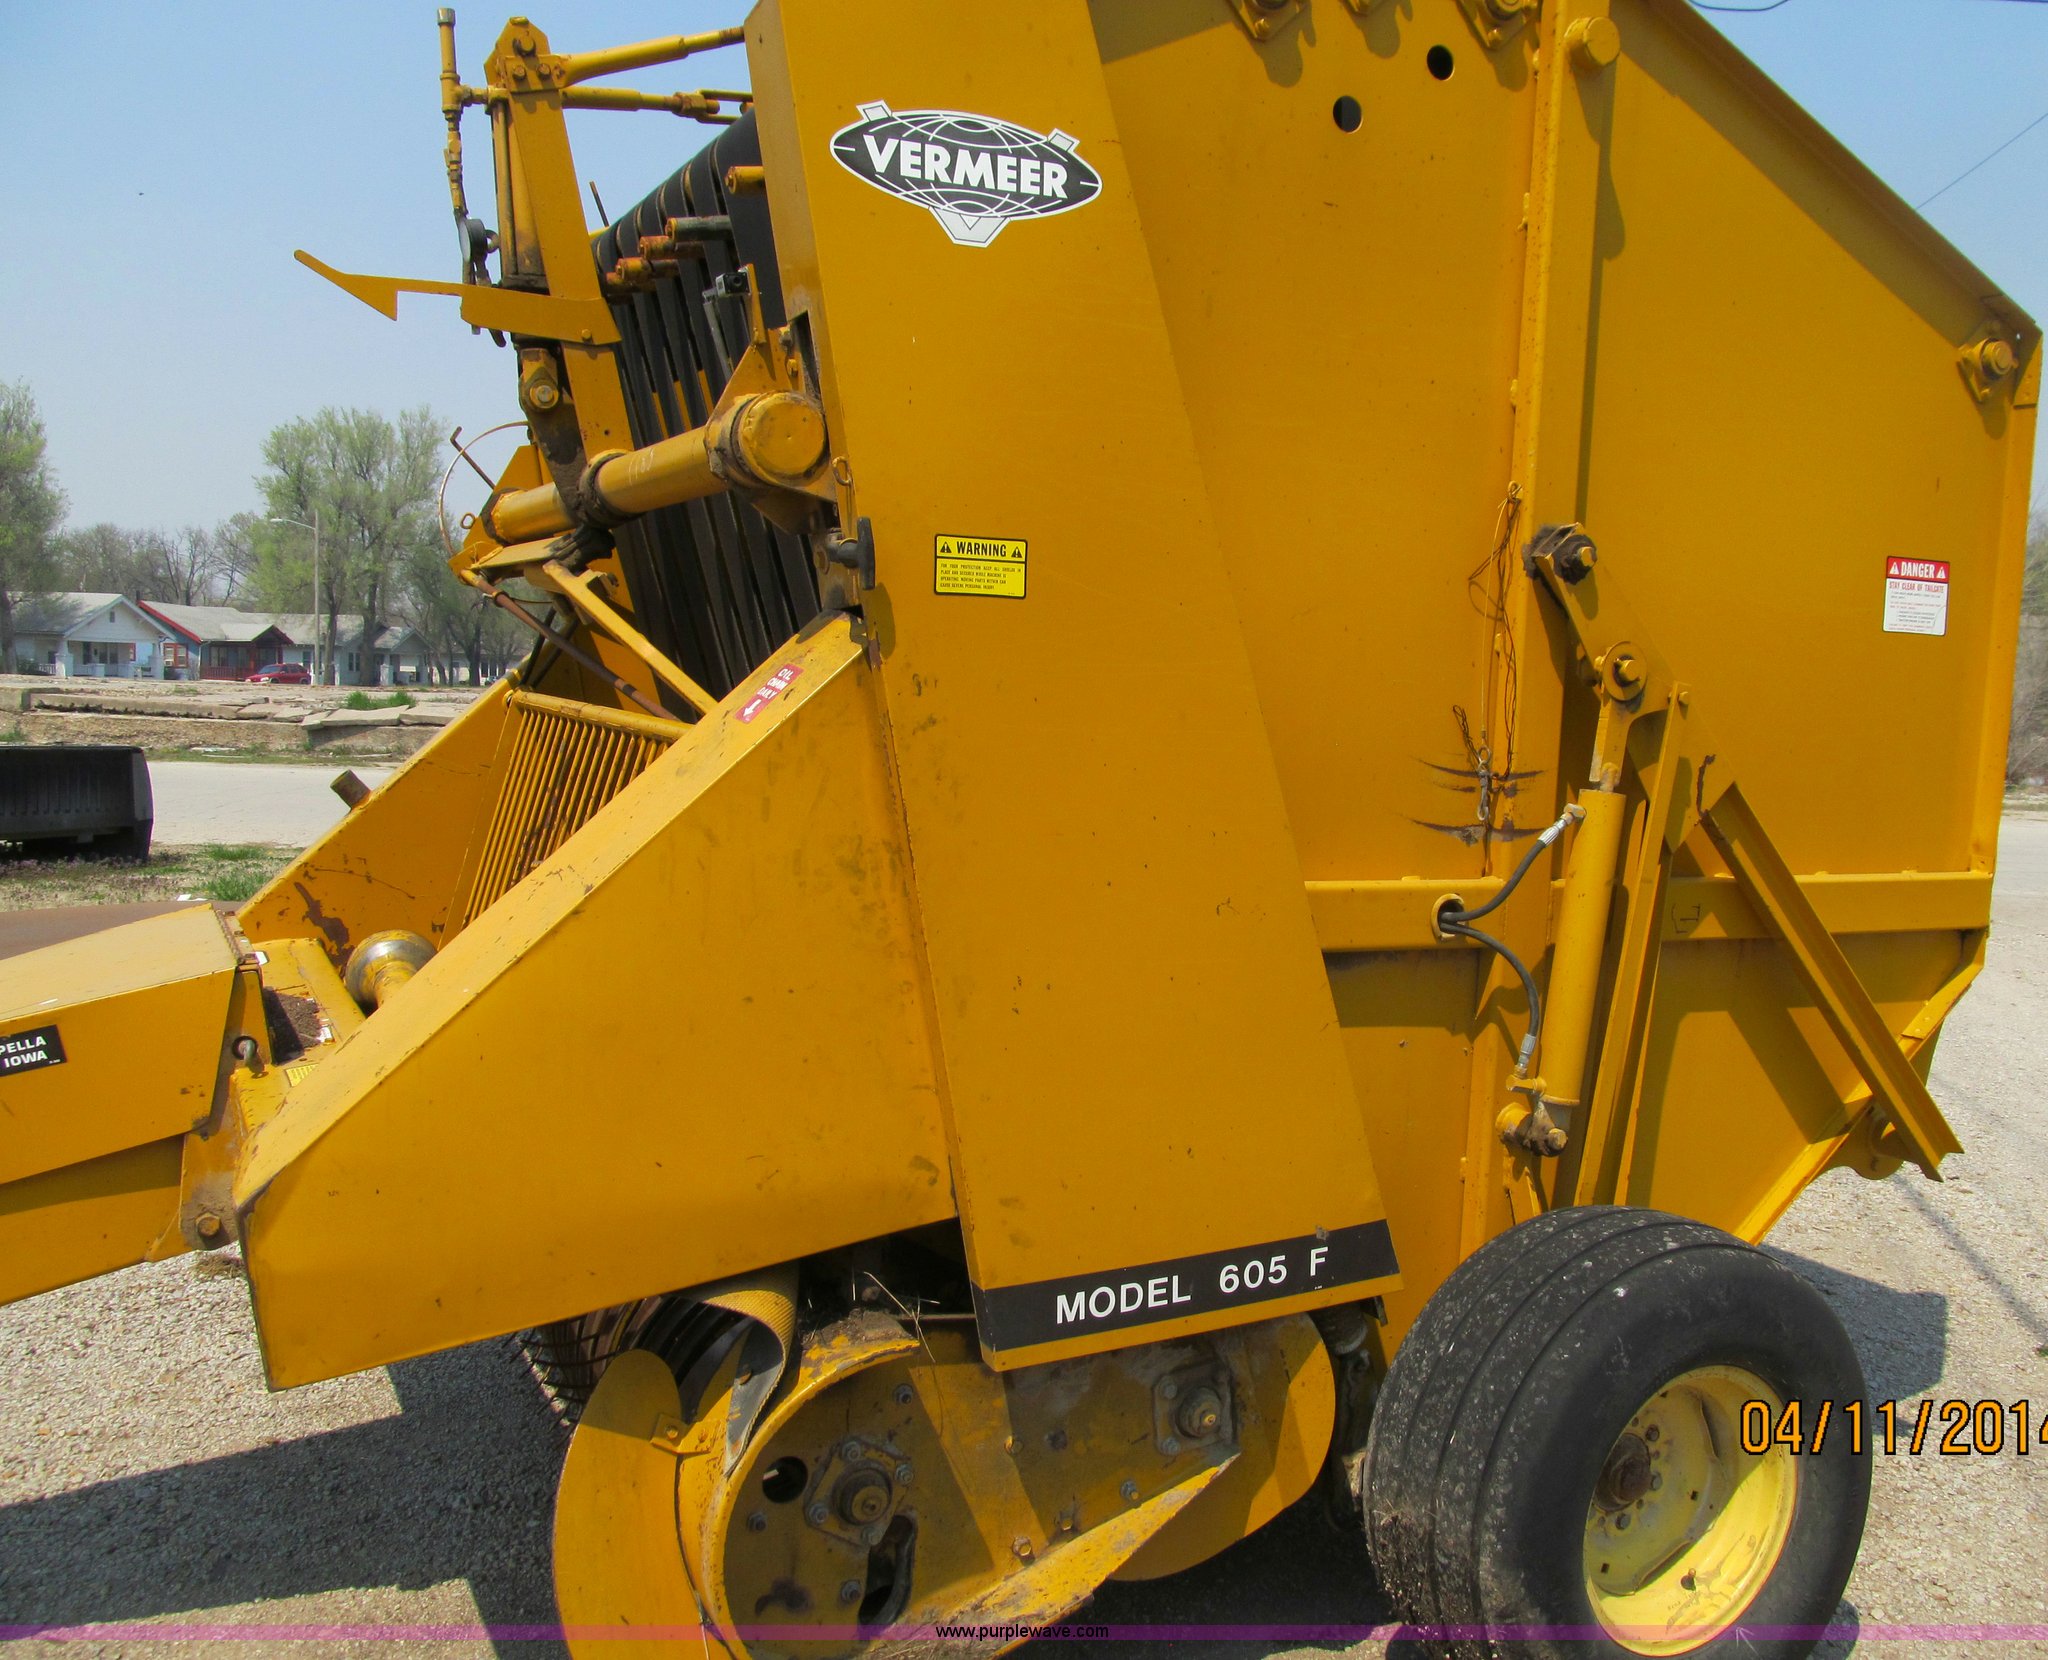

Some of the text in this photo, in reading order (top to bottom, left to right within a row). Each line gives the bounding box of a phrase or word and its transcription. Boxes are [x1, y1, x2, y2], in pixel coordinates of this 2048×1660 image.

[863, 134, 1068, 199] VERMEER
[956, 541, 1007, 557] WARNING
[1901, 561, 1935, 578] DANGER
[4, 1050, 48, 1068] IOWA
[1056, 1246, 1329, 1324] MODEL 605 F
